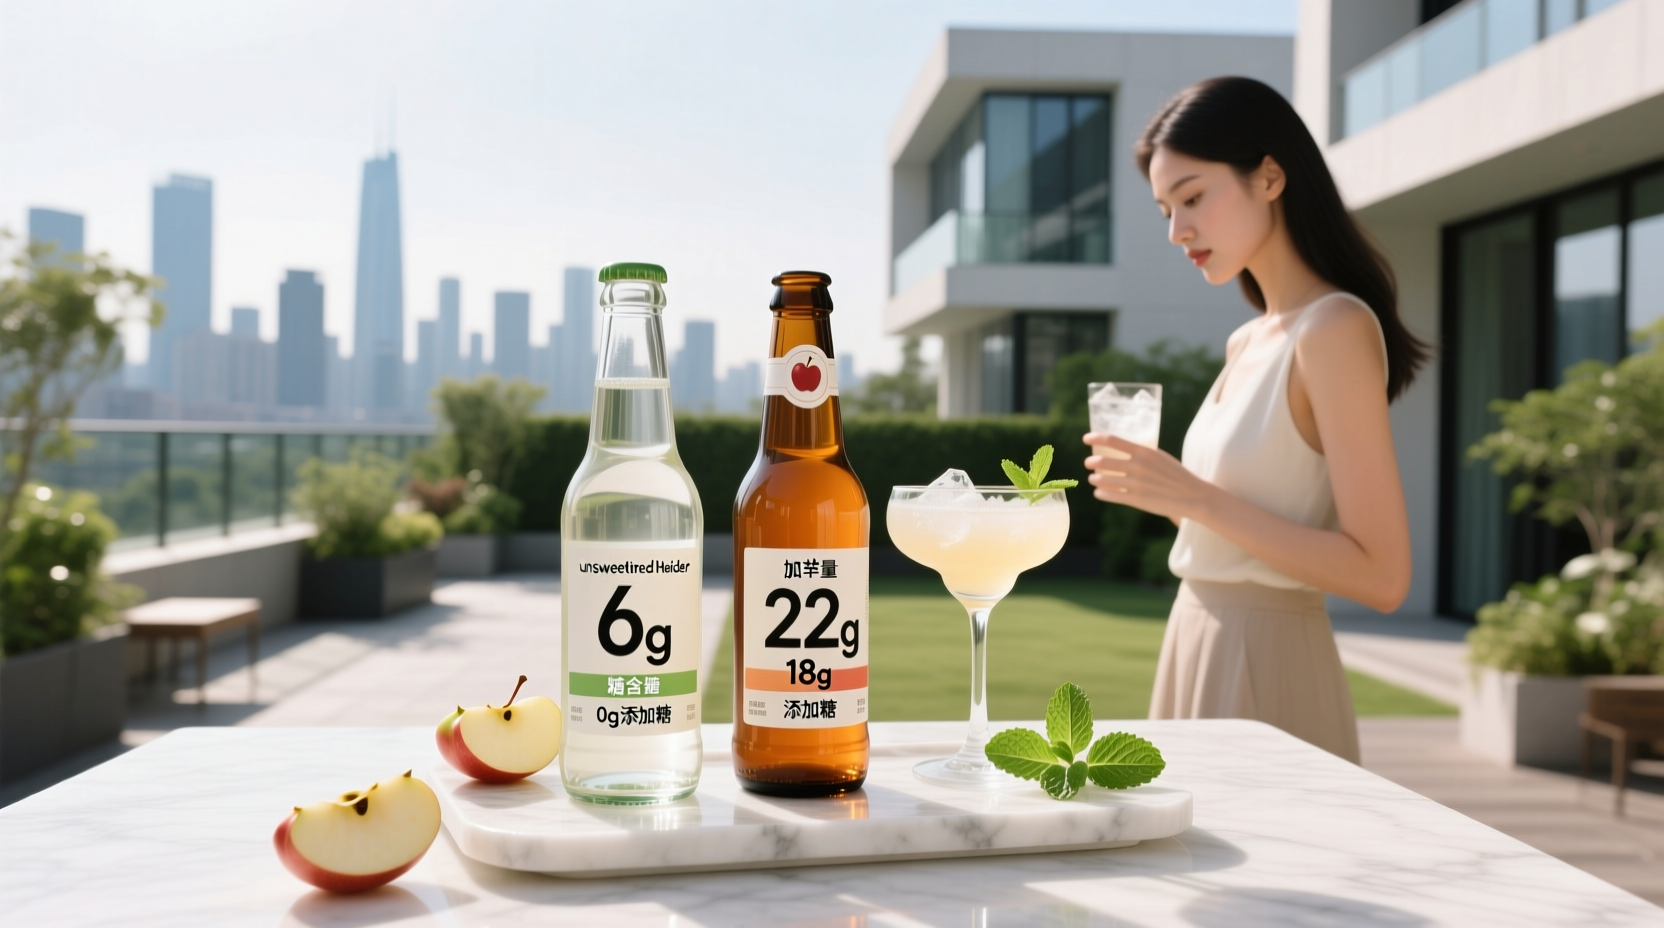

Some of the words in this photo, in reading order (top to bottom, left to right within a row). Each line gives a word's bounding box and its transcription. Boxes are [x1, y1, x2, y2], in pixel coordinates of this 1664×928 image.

[598, 585, 671, 666] 6g
[765, 588, 859, 658] 22g
[786, 659, 831, 690] 18g
[784, 699, 837, 719] 添加糖
